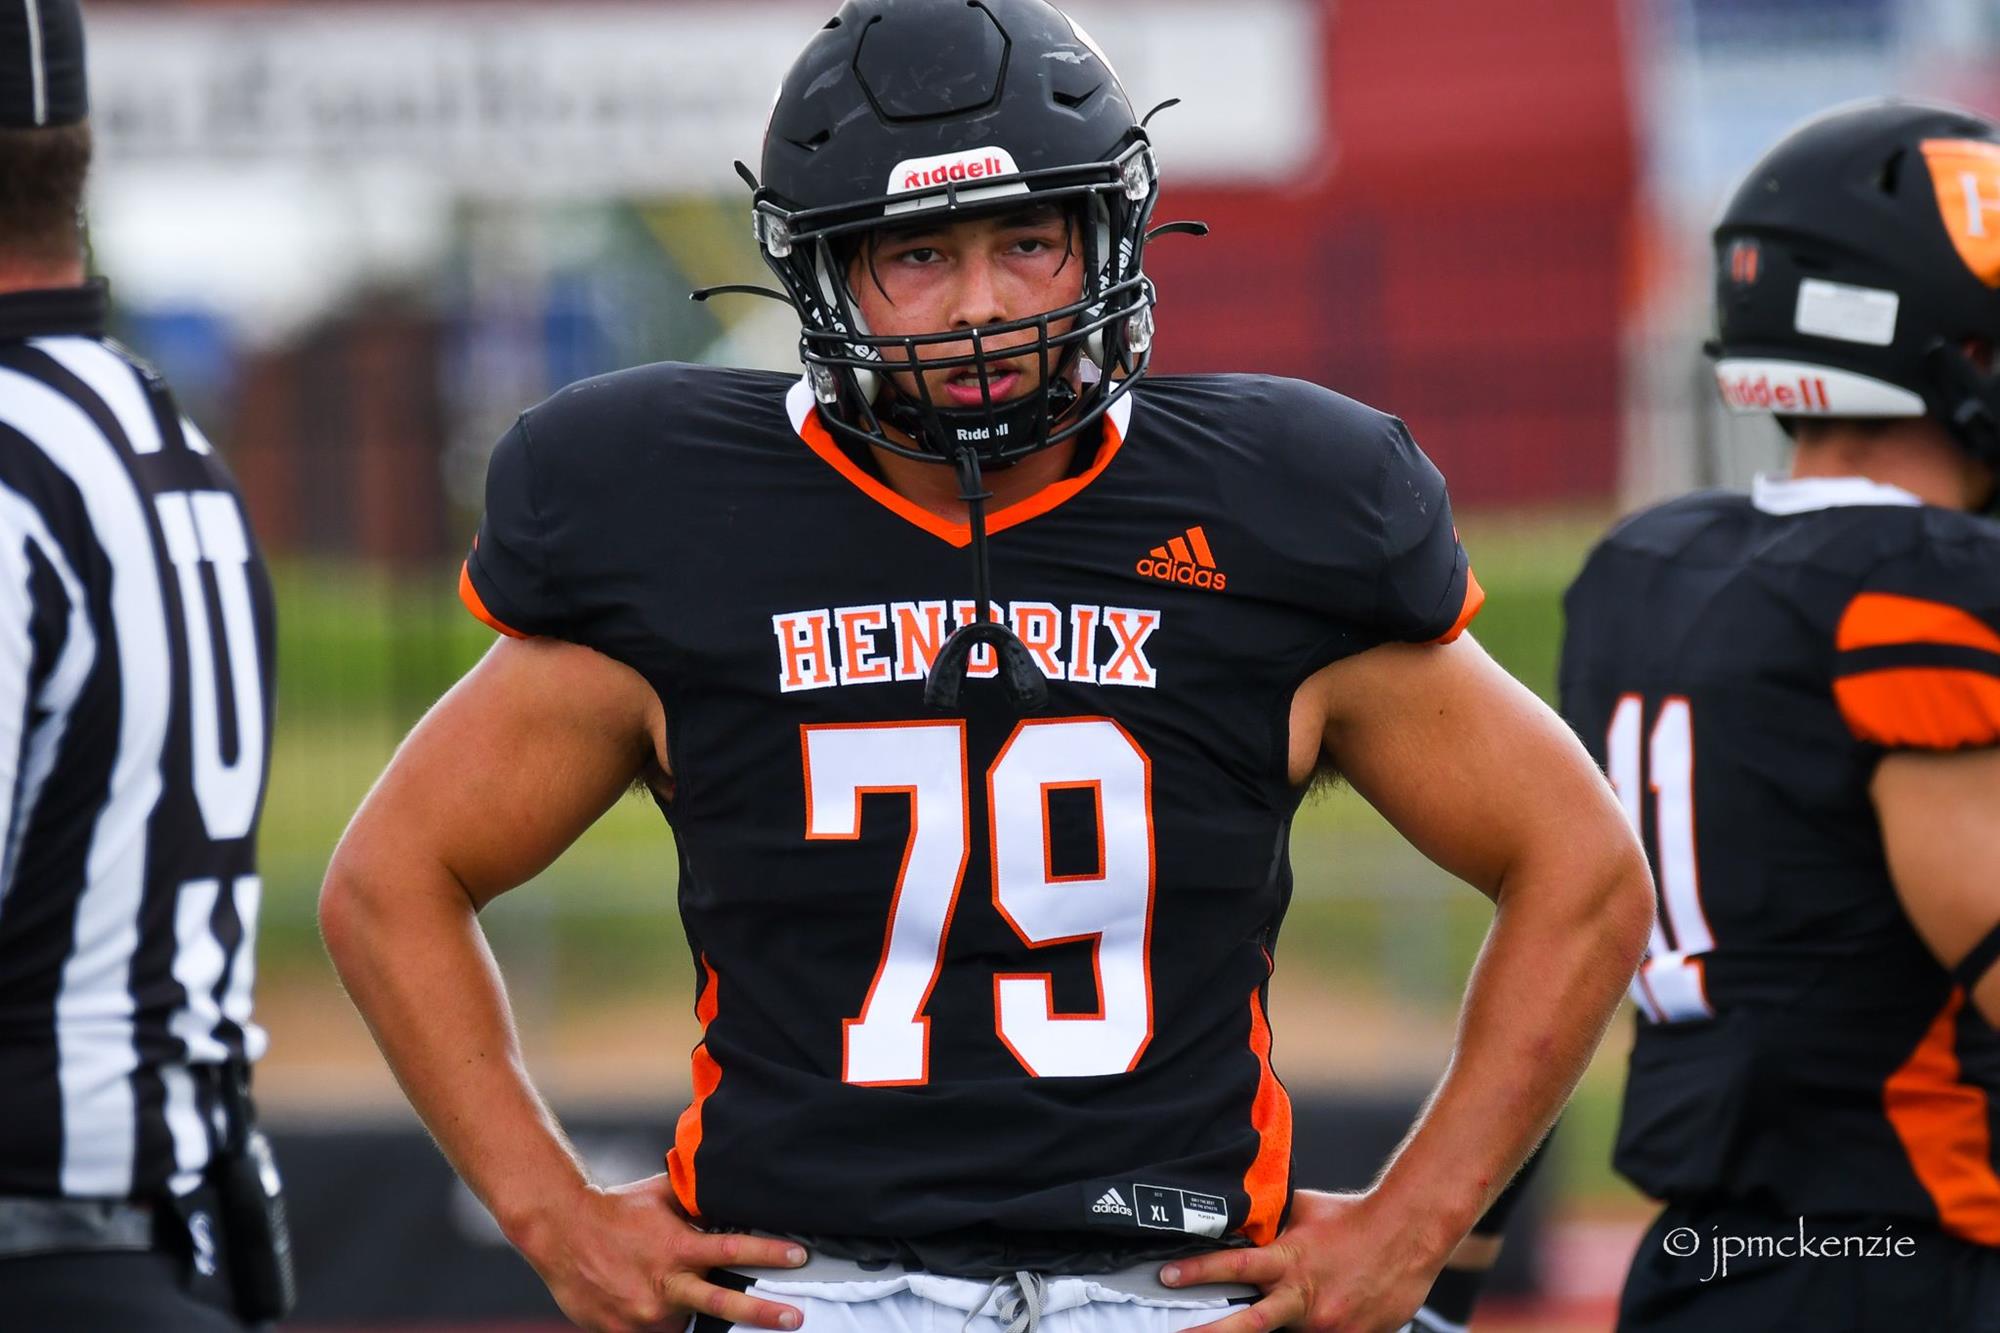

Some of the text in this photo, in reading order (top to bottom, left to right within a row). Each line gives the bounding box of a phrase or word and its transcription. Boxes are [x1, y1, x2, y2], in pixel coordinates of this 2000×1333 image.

[904, 156, 1002, 189] Riddell
[1136, 558, 1226, 591] adidas
[800, 715, 1157, 1088] 79
[1092, 1202, 1133, 1217] adidas
[1150, 1204, 1170, 1222] XL
